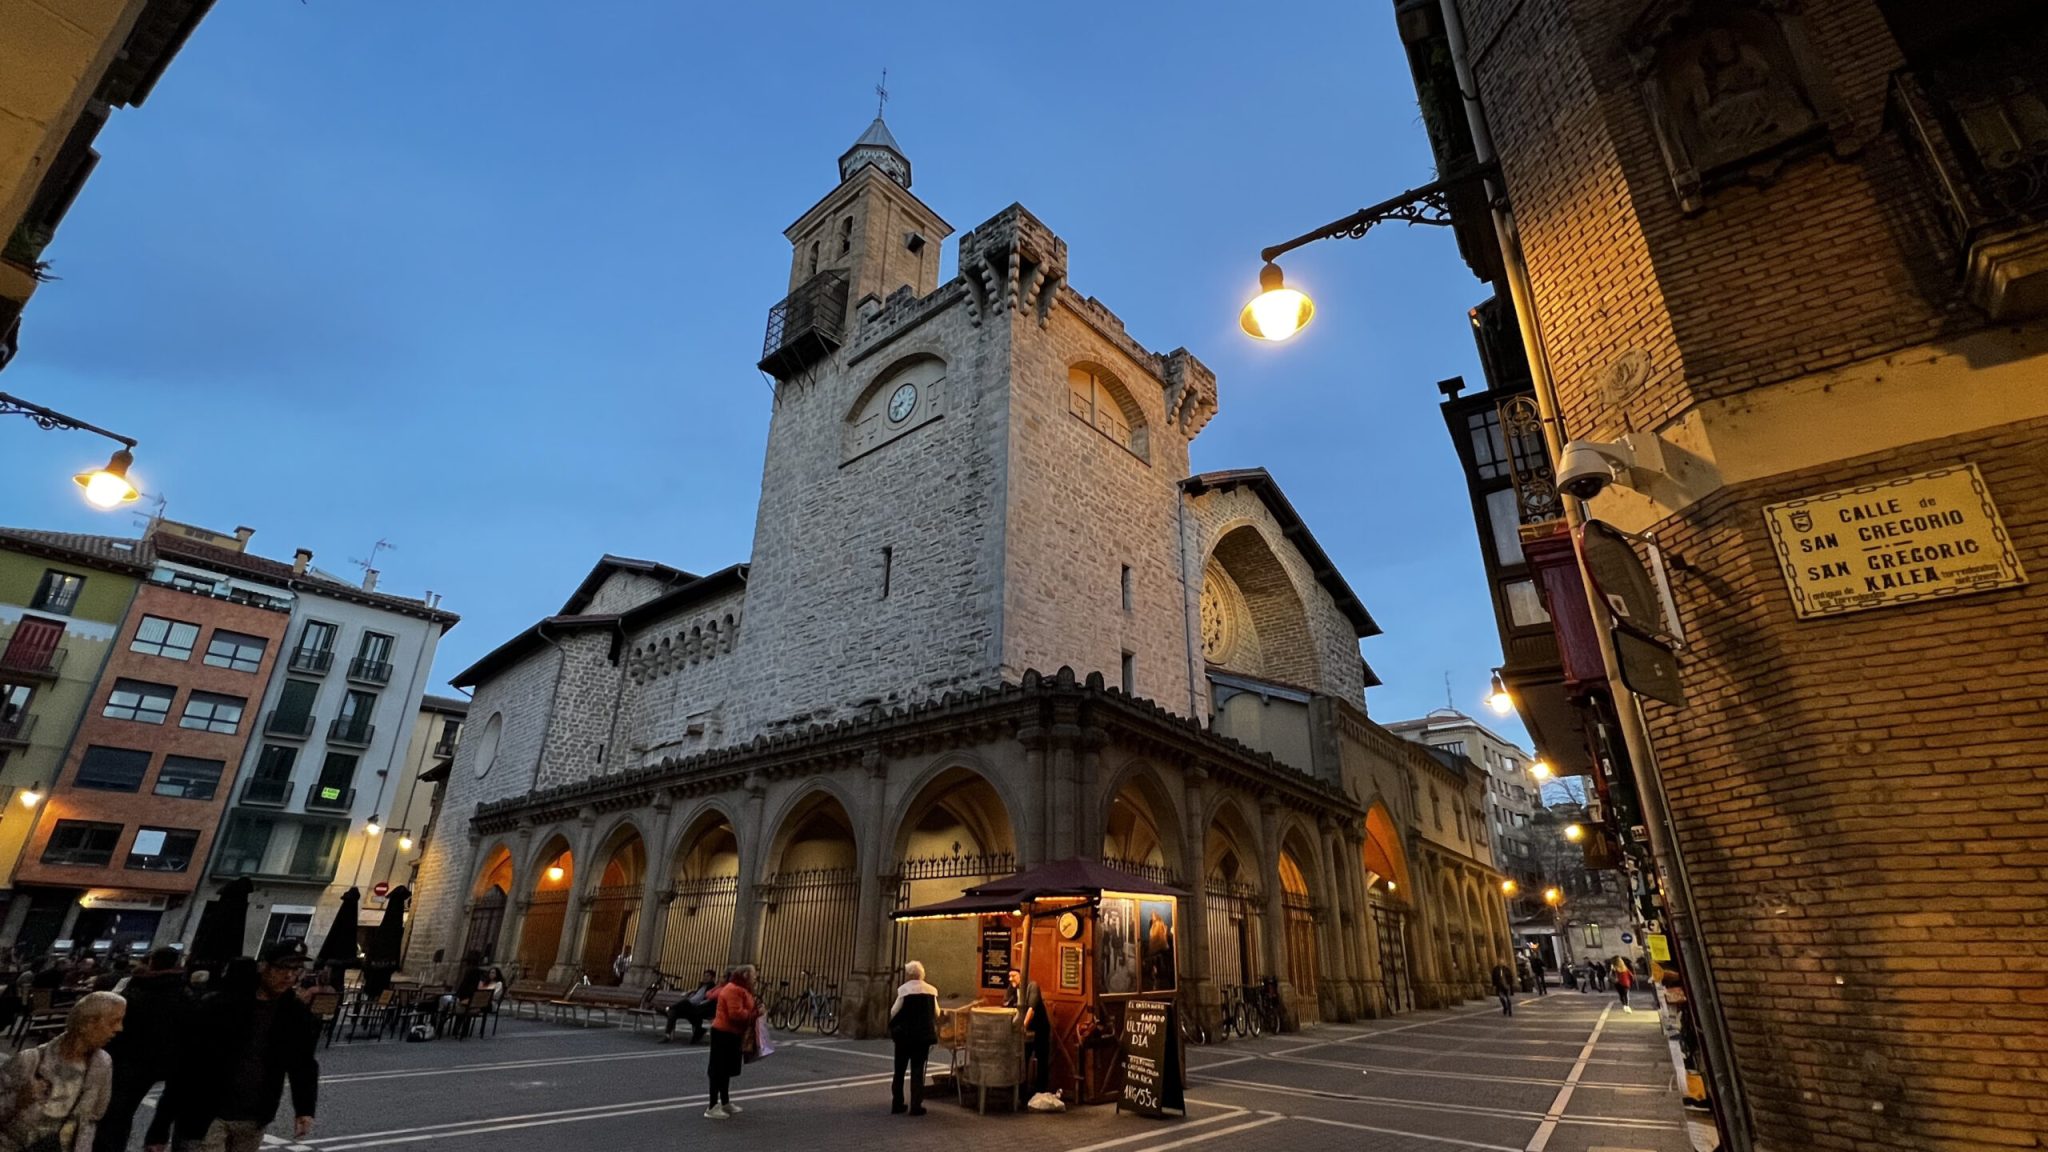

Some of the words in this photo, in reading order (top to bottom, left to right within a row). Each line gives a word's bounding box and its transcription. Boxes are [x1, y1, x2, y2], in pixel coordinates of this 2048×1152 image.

[1839, 499, 1902, 523] CALLE
[1919, 498, 1936, 509] de
[1800, 533, 1839, 553] SAN
[1858, 509, 1965, 541] GREGORIO
[1807, 561, 1851, 581] SAN
[1867, 538, 1979, 570] GREGORIO
[1864, 566, 1941, 592] KALEA
